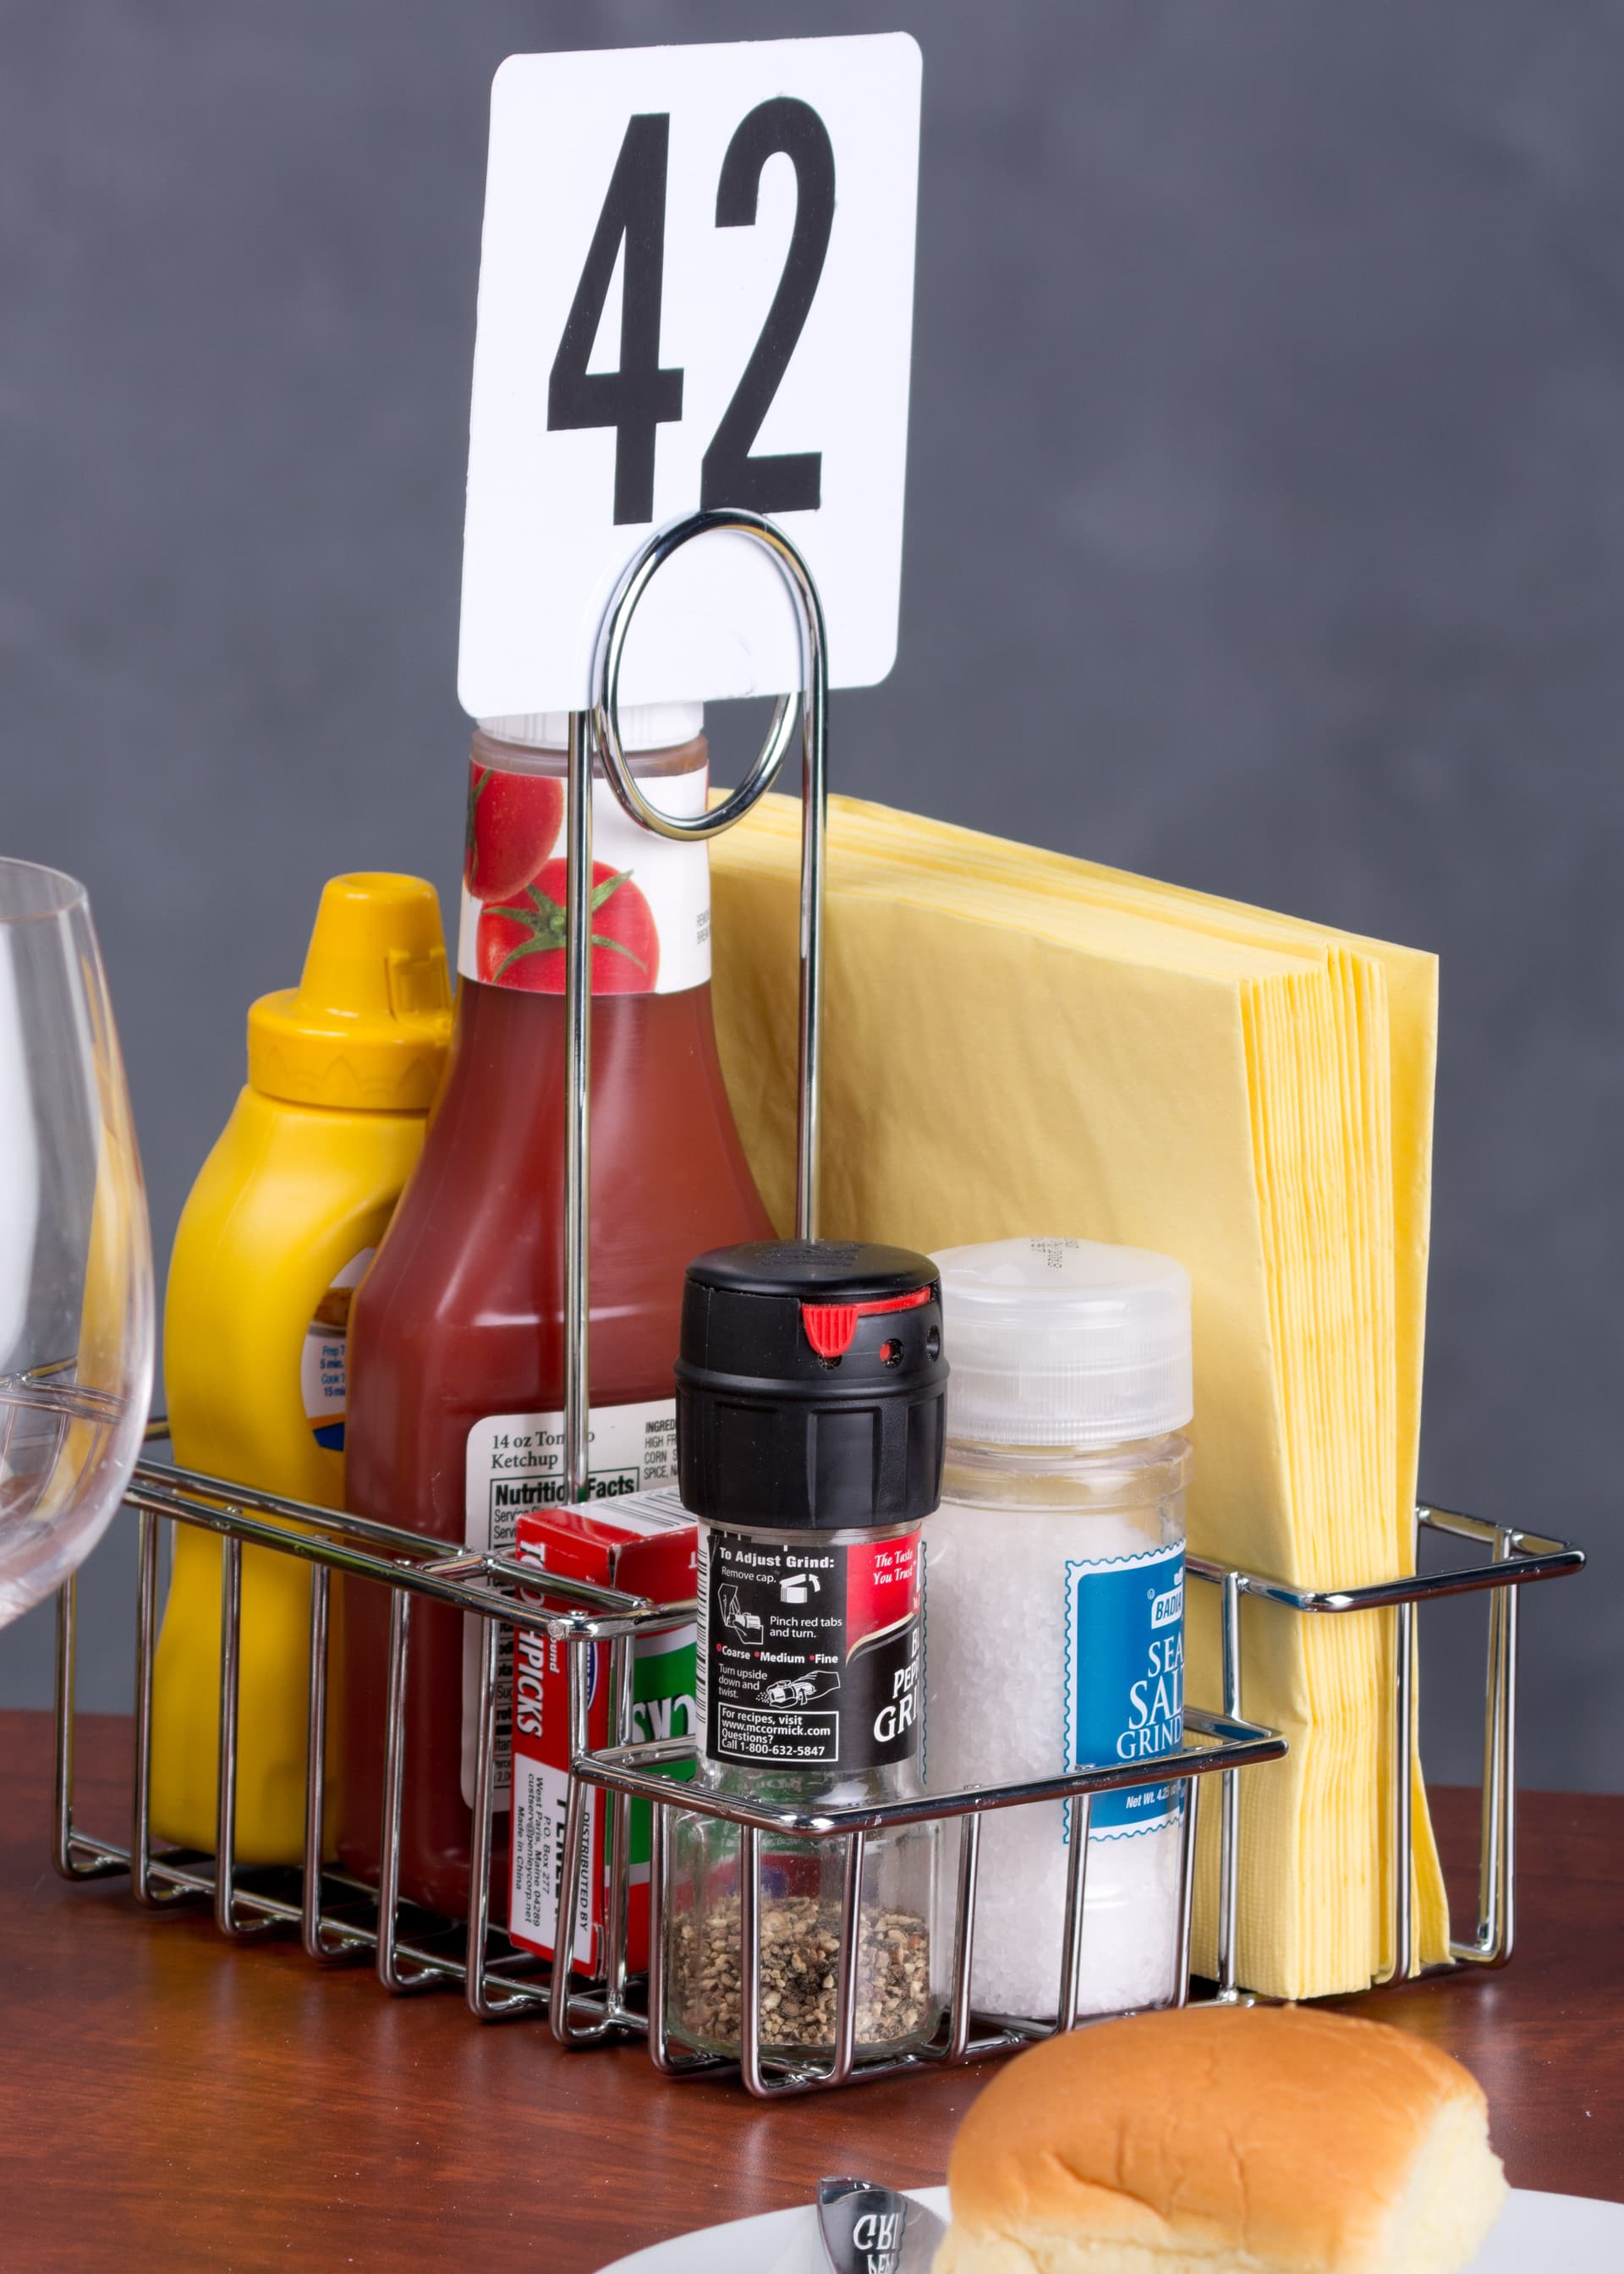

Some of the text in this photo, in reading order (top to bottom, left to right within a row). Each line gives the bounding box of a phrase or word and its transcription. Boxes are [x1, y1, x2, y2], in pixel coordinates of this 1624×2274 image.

[547, 95, 836, 525] 42
[493, 1431, 595, 1449] 14 oz Tomo
[645, 1436, 663, 1449] HIGH
[491, 1452, 558, 1469] Ketchup
[644, 1450, 667, 1464] CORN
[644, 1465, 668, 1480] SPICE,
[496, 1475, 634, 1506] Nutritio Facts
[720, 1547, 835, 1568] To Adjust Grind:
[875, 1548, 913, 1568] The Taste
[721, 1566, 776, 1584] Remove cap.
[873, 1565, 913, 1585] You Trust
[770, 1616, 842, 1627] Pinch red tabs
[770, 1629, 789, 1638] and
[549, 1636, 560, 1674] ound
[722, 1645, 838, 1664] Coarse Medium Fine
[1148, 1631, 1183, 1678] SEA
[719, 1663, 768, 1680] Turn upside
[719, 1675, 760, 1690] down and
[719, 1686, 738, 1699] twist.
[721, 1707, 803, 1725] For recipes, visit
[721, 1719, 831, 1736] www.mccormick.com
[721, 1728, 773, 1744] Questions?
[721, 1738, 825, 1756] Call 1-800-632-5847
[1126, 1794, 1142, 1809] Net
[517, 1805, 525, 1837] Made
[534, 1811, 542, 1845] Paris,
[517, 1841, 524, 1852] in
[524, 1773, 535, 1923] custserv@penleycorp.net
[534, 1850, 542, 1887] Maine
[580, 1812, 590, 1931] DISTRIBUTED BY
